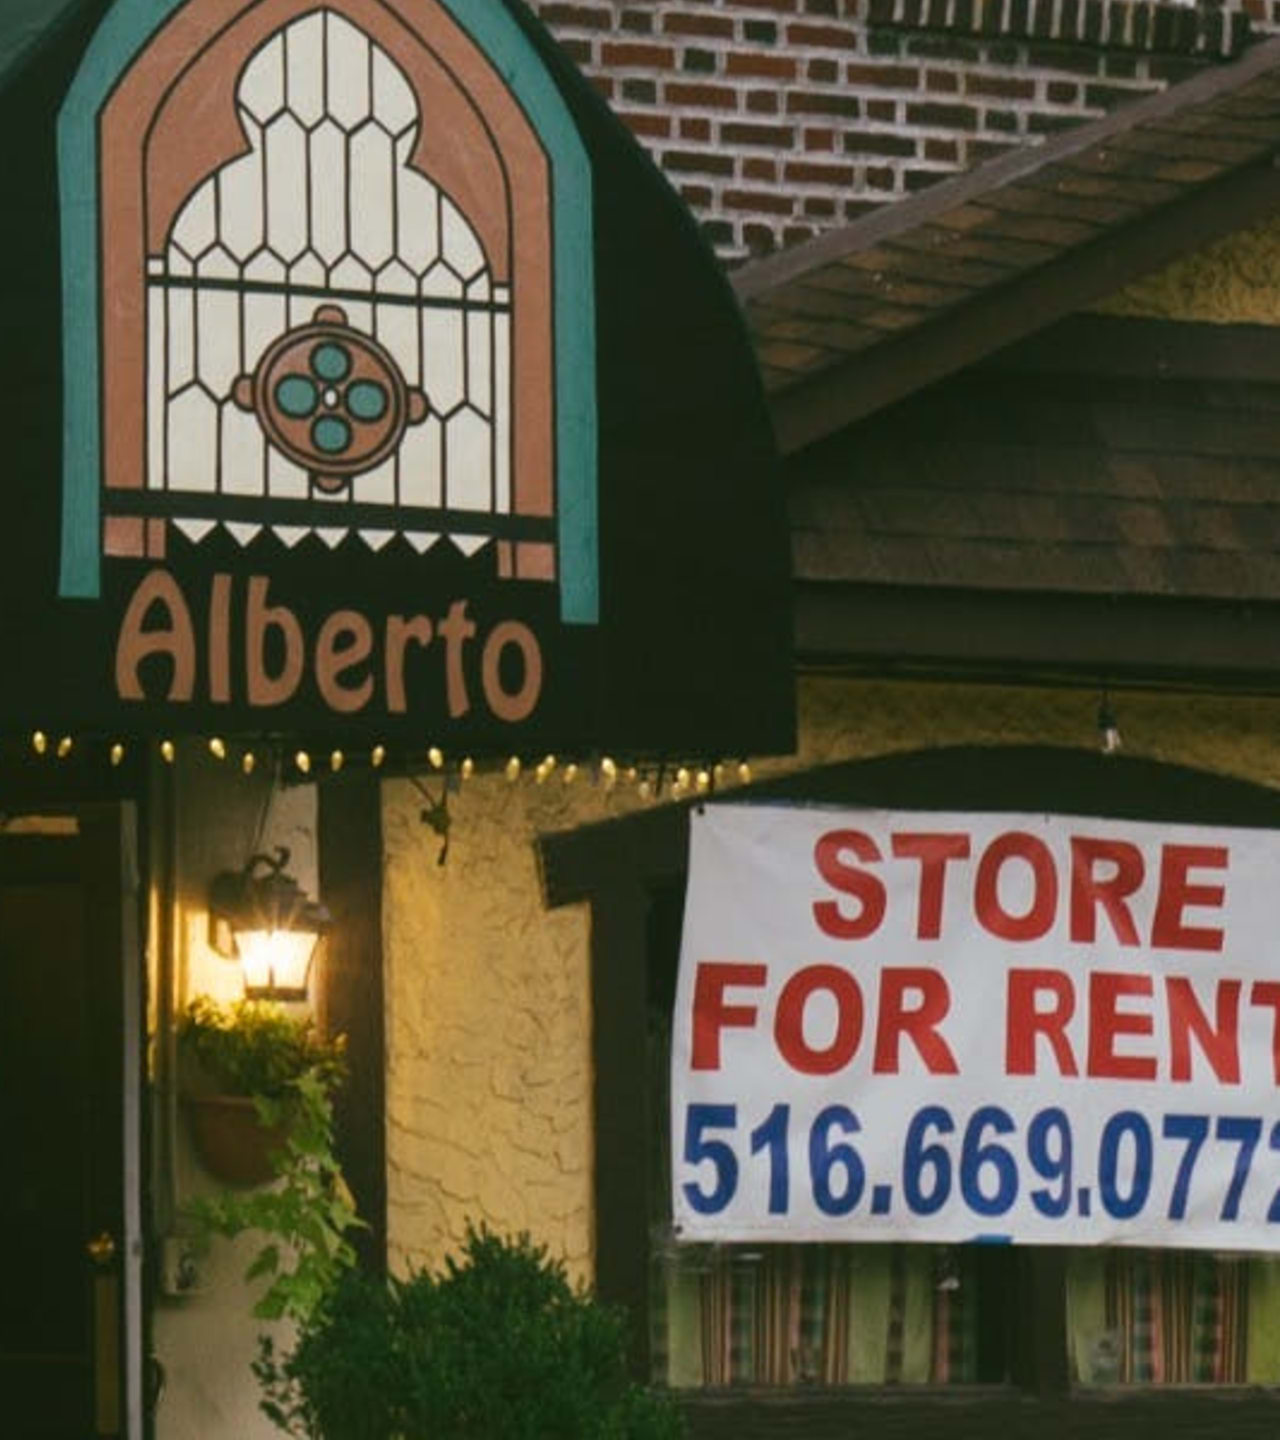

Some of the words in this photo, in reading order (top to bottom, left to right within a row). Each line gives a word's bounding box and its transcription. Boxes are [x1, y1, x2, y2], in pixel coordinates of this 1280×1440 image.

[114, 569, 542, 722] Alberto
[813, 829, 1229, 952] STORE
[690, 962, 960, 1075] FOR
[682, 1103, 1280, 1224] 516.669.077
